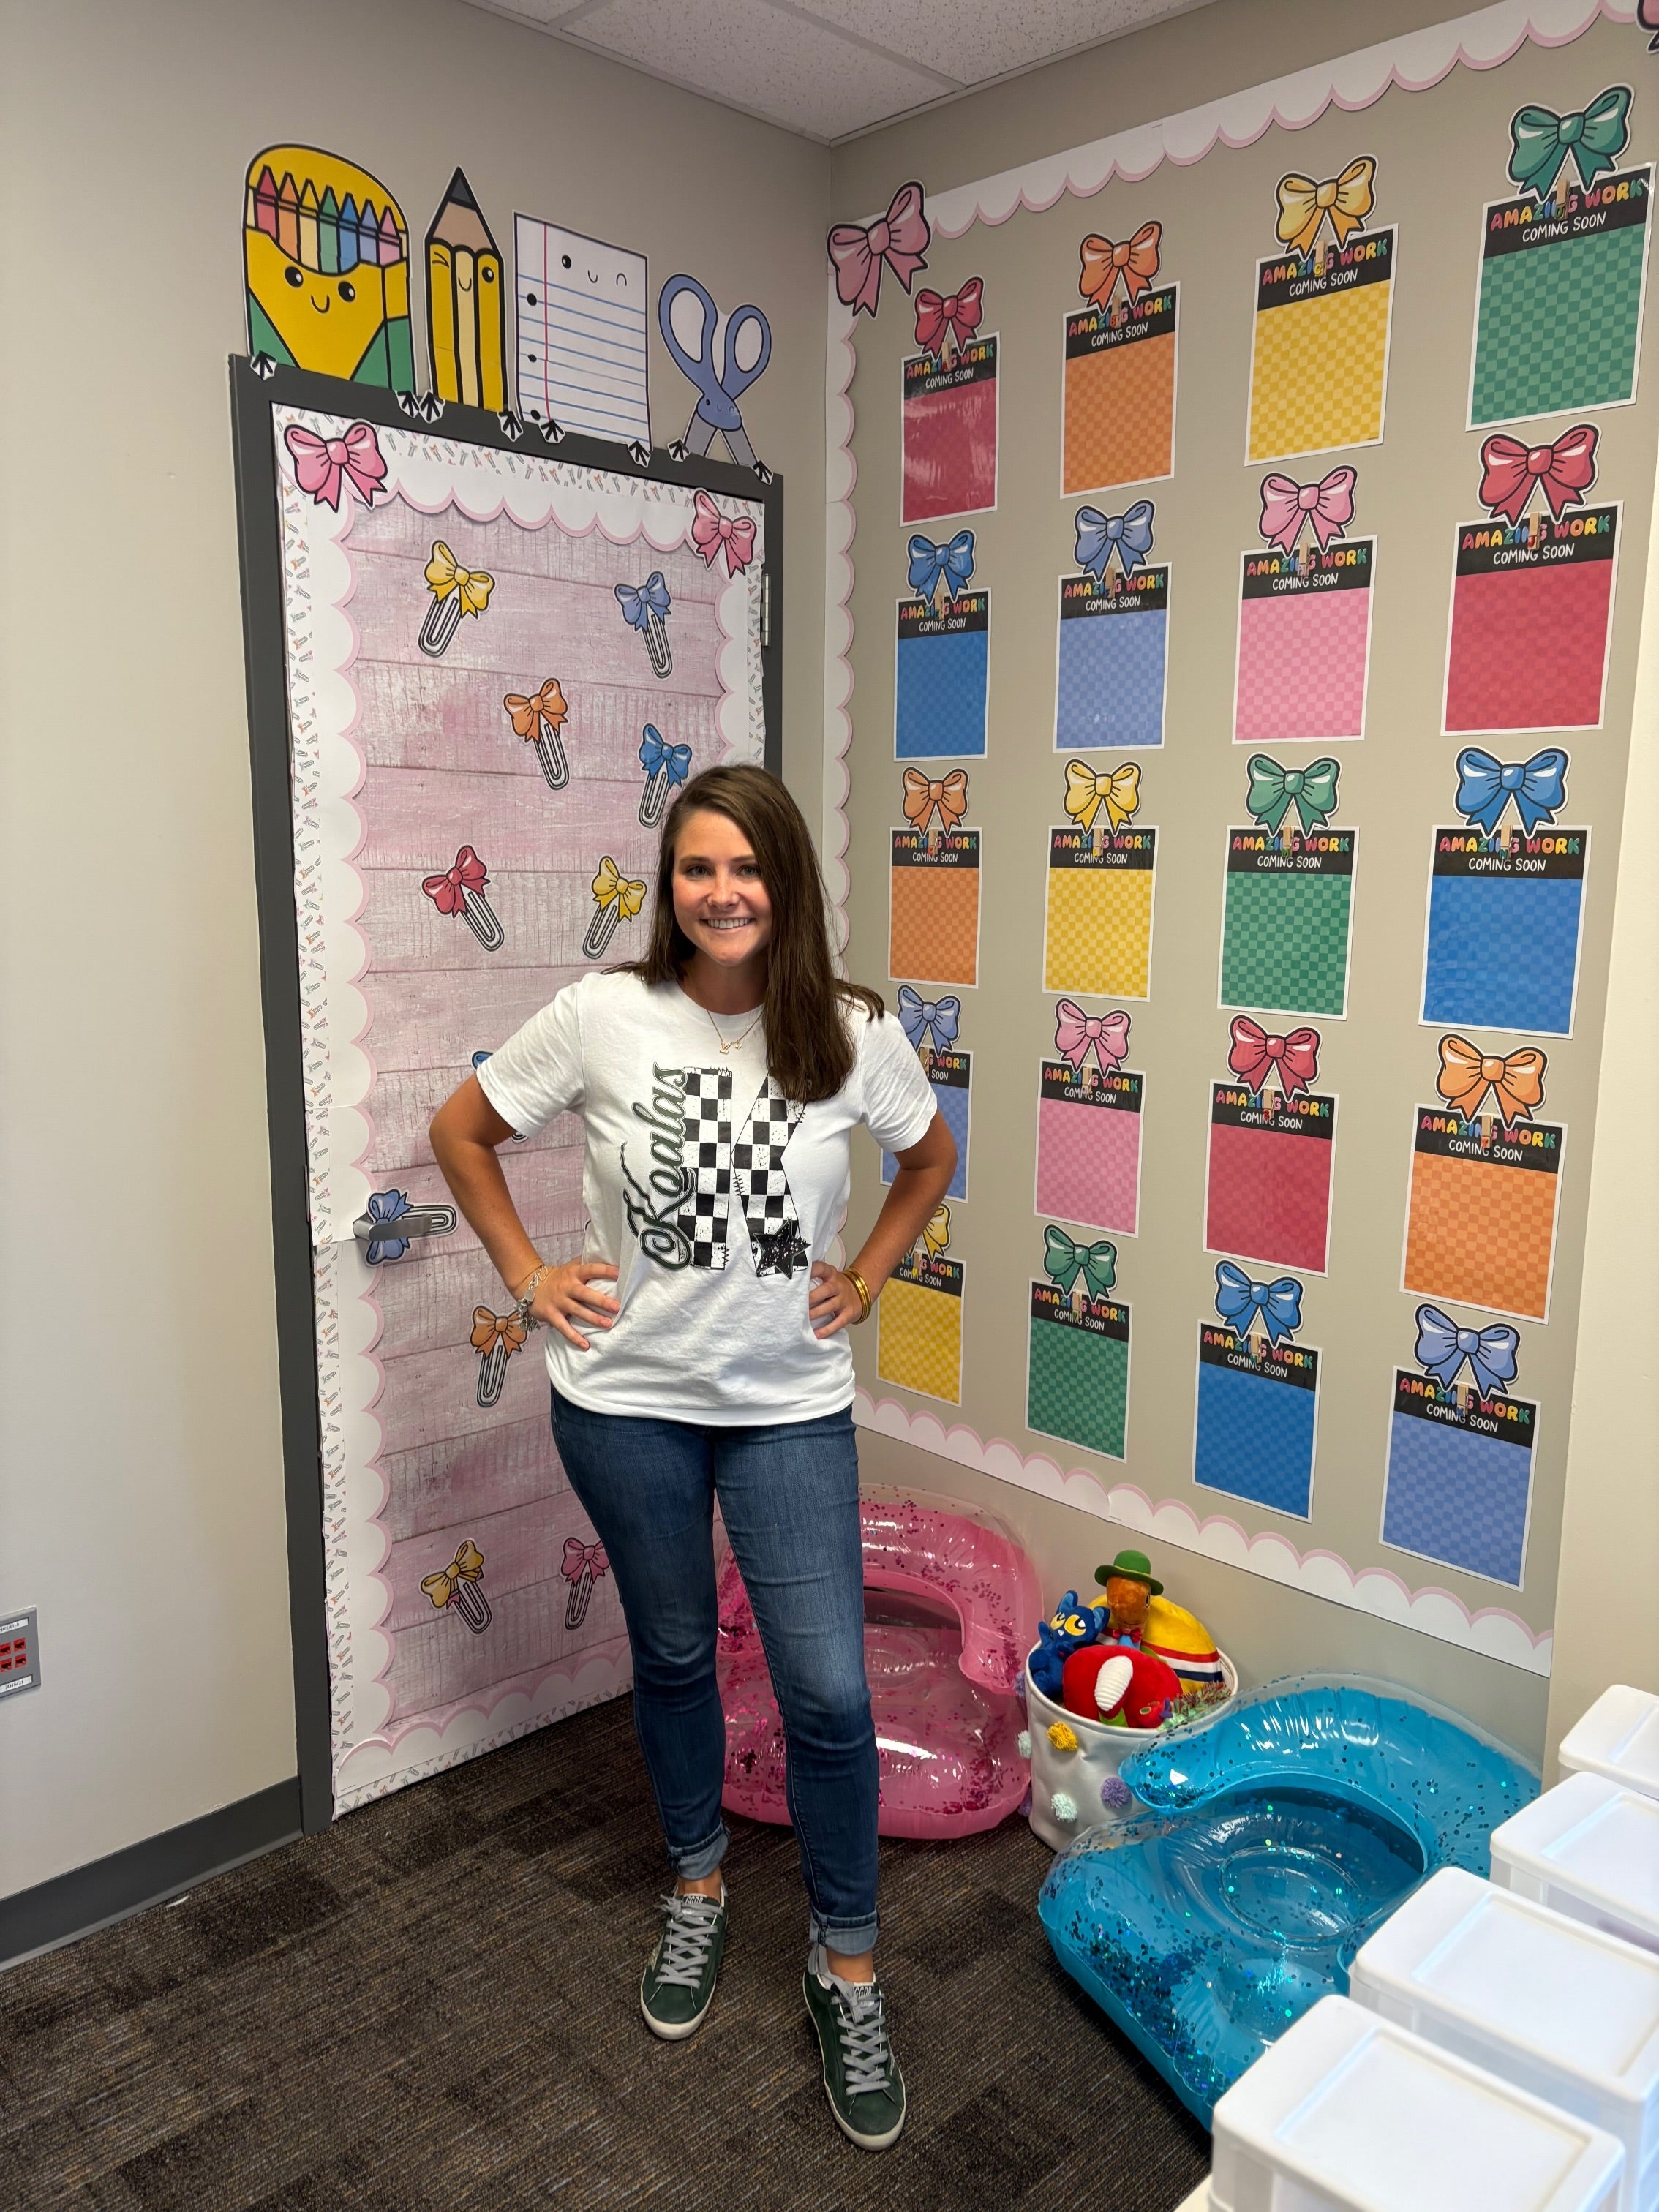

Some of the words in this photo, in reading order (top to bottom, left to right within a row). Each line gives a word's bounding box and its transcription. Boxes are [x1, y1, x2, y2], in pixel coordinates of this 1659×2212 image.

[1584, 178, 1643, 208] WORK
[1522, 220, 1568, 242] COMING
[1573, 211, 1606, 231] SOON
[1263, 252, 1334, 285] AMAZIG
[1340, 238, 1387, 266] WORK
[1289, 276, 1327, 296] COMING
[1331, 268, 1358, 286] SOON
[1069, 307, 1128, 337] AMAZIG
[1133, 294, 1172, 320] WORK
[1091, 329, 1123, 347] COMING
[1126, 322, 1148, 339] SOON
[906, 354, 958, 379] AMAZIG
[960, 344, 993, 365] WORK
[925, 373, 953, 389] COMING
[955, 367, 974, 383] SOON
[1554, 515, 1610, 539] WORK
[1246, 554, 1316, 576] AMAZIG
[1321, 548, 1367, 568] WORK
[1493, 549, 1538, 565] COMING
[1542, 543, 1574, 560] SOON
[1064, 579, 1122, 598] AMAZIG
[1126, 573, 1164, 591] WORK
[1272, 576, 1309, 590] COMING
[1312, 573, 1339, 587] SOON
[900, 603, 949, 620] AMAZIG
[953, 597, 985, 614] WORK
[1086, 598, 1116, 611] COMING
[1119, 595, 1140, 608] SOON
[919, 620, 945, 632] COMING
[947, 617, 966, 629] SOON
[895, 835, 942, 849] AMAZIG
[945, 836, 977, 849] WORK
[1053, 835, 1110, 849] AMAZIG
[1113, 835, 1151, 849] WORK
[1232, 836, 1300, 851] AMAZIG
[1305, 837, 1350, 853] WORK
[1526, 837, 1580, 854] WORK
[940, 851, 958, 862] SOON
[1106, 852, 1128, 864] SOON
[1257, 854, 1293, 868] COMING
[1296, 855, 1322, 868] SOON
[1468, 857, 1511, 871] COMING
[1515, 858, 1546, 872] SOON
[937, 1056, 967, 1071] WORK
[931, 1069, 949, 1081] SOON
[1044, 1067, 1099, 1086] AMAZIG
[1102, 1076, 1139, 1093] WORK
[1095, 1091, 1116, 1104] SOON
[1216, 1090, 1281, 1111] AMAZIG
[1287, 1099, 1330, 1118] WORK
[1278, 1116, 1303, 1129] SOON
[1504, 1128, 1556, 1148] WORK
[1494, 1145, 1524, 1161] SOON
[620, 1061, 698, 1272] Koalas
[925, 1274, 942, 1287] SOON
[930, 1263, 960, 1279] WORK
[1034, 1288, 1088, 1312] AMAZIG
[1091, 1305, 1126, 1323] WORK
[1085, 1316, 1105, 1331] SOON
[1203, 1331, 1267, 1358] AMAZIG
[1272, 1348, 1313, 1369] WORK
[1264, 1362, 1287, 1378] SOON
[1480, 1400, 1530, 1425] WORK
[1470, 1414, 1499, 1433] SOON
